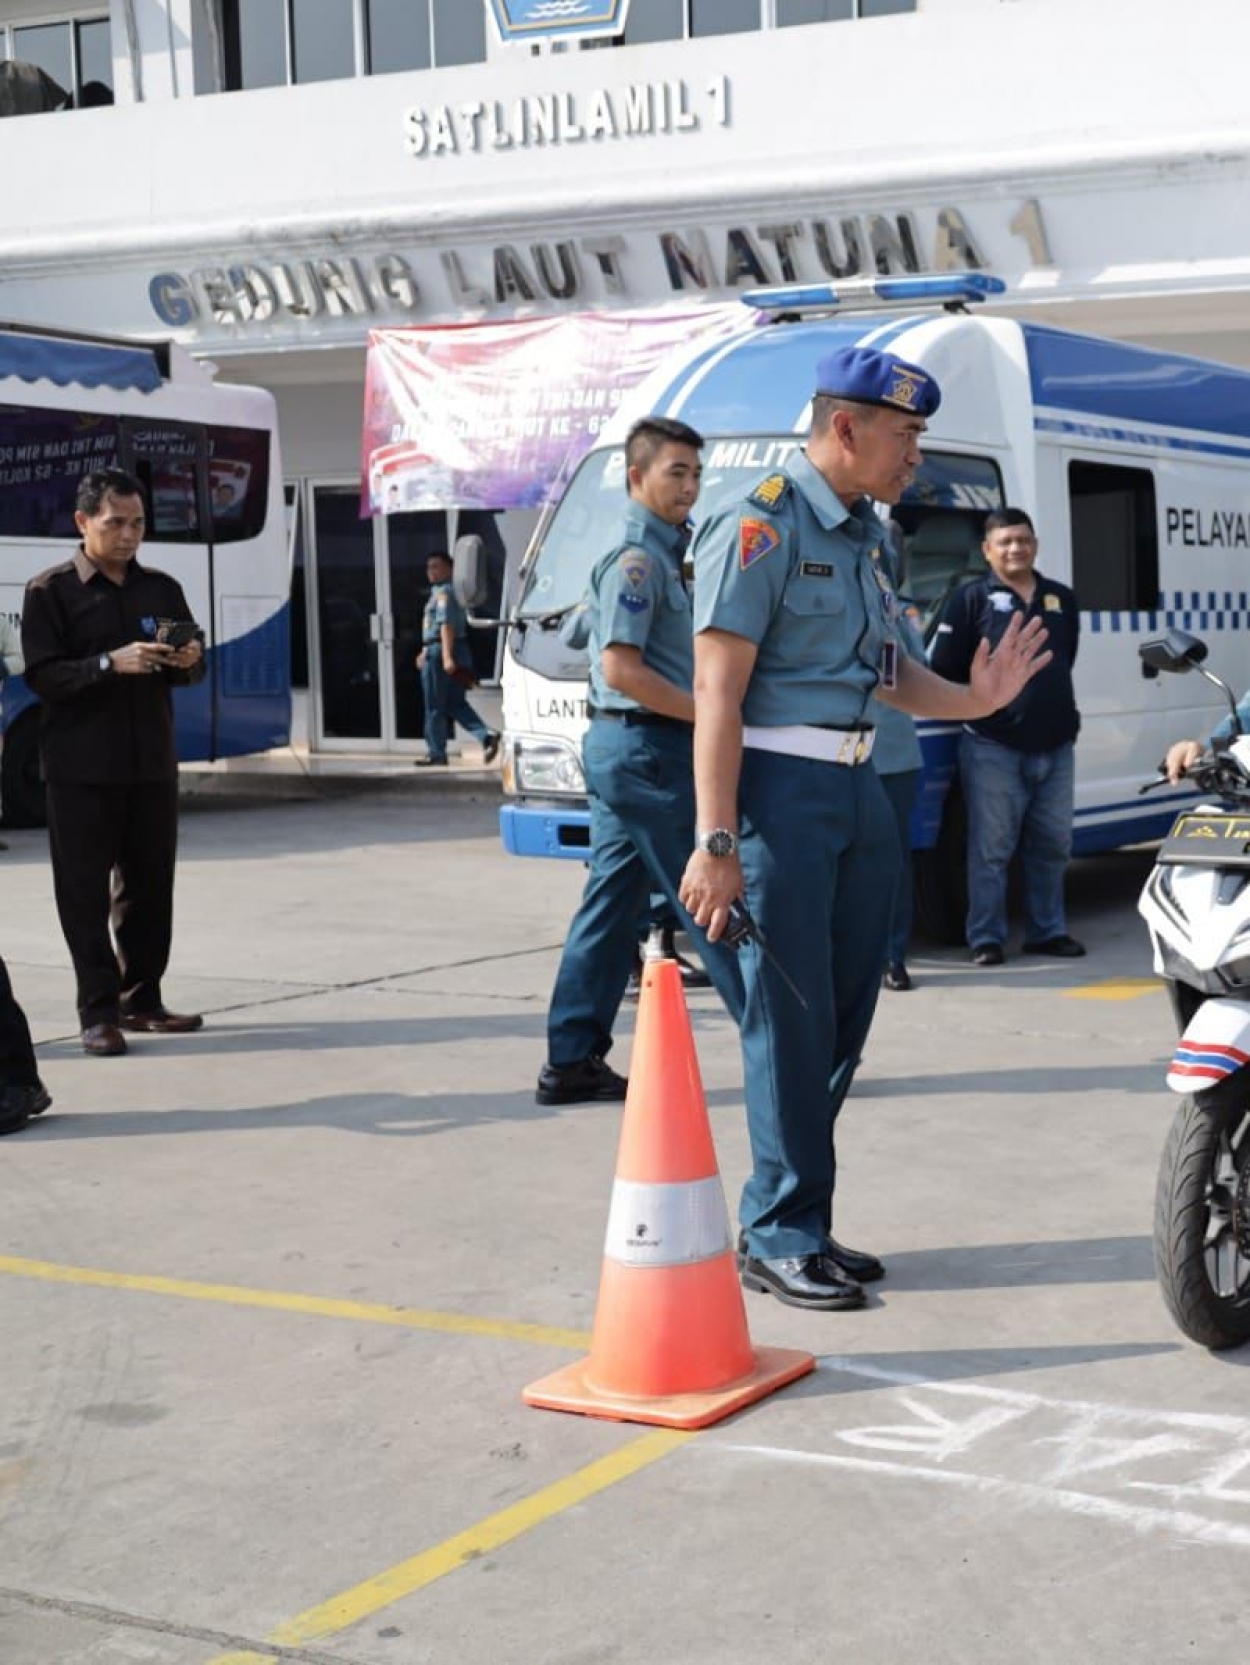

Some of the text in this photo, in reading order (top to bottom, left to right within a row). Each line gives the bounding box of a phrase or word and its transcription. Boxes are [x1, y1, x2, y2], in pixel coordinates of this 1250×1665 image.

[404, 75, 731, 157] SATLINLAMIL 1
[148, 198, 1052, 326] GEDUNG LAUT NATUNA 1
[550, 417, 571, 437] KE
[707, 441, 809, 468] MILIT
[537, 699, 588, 718] LANT
